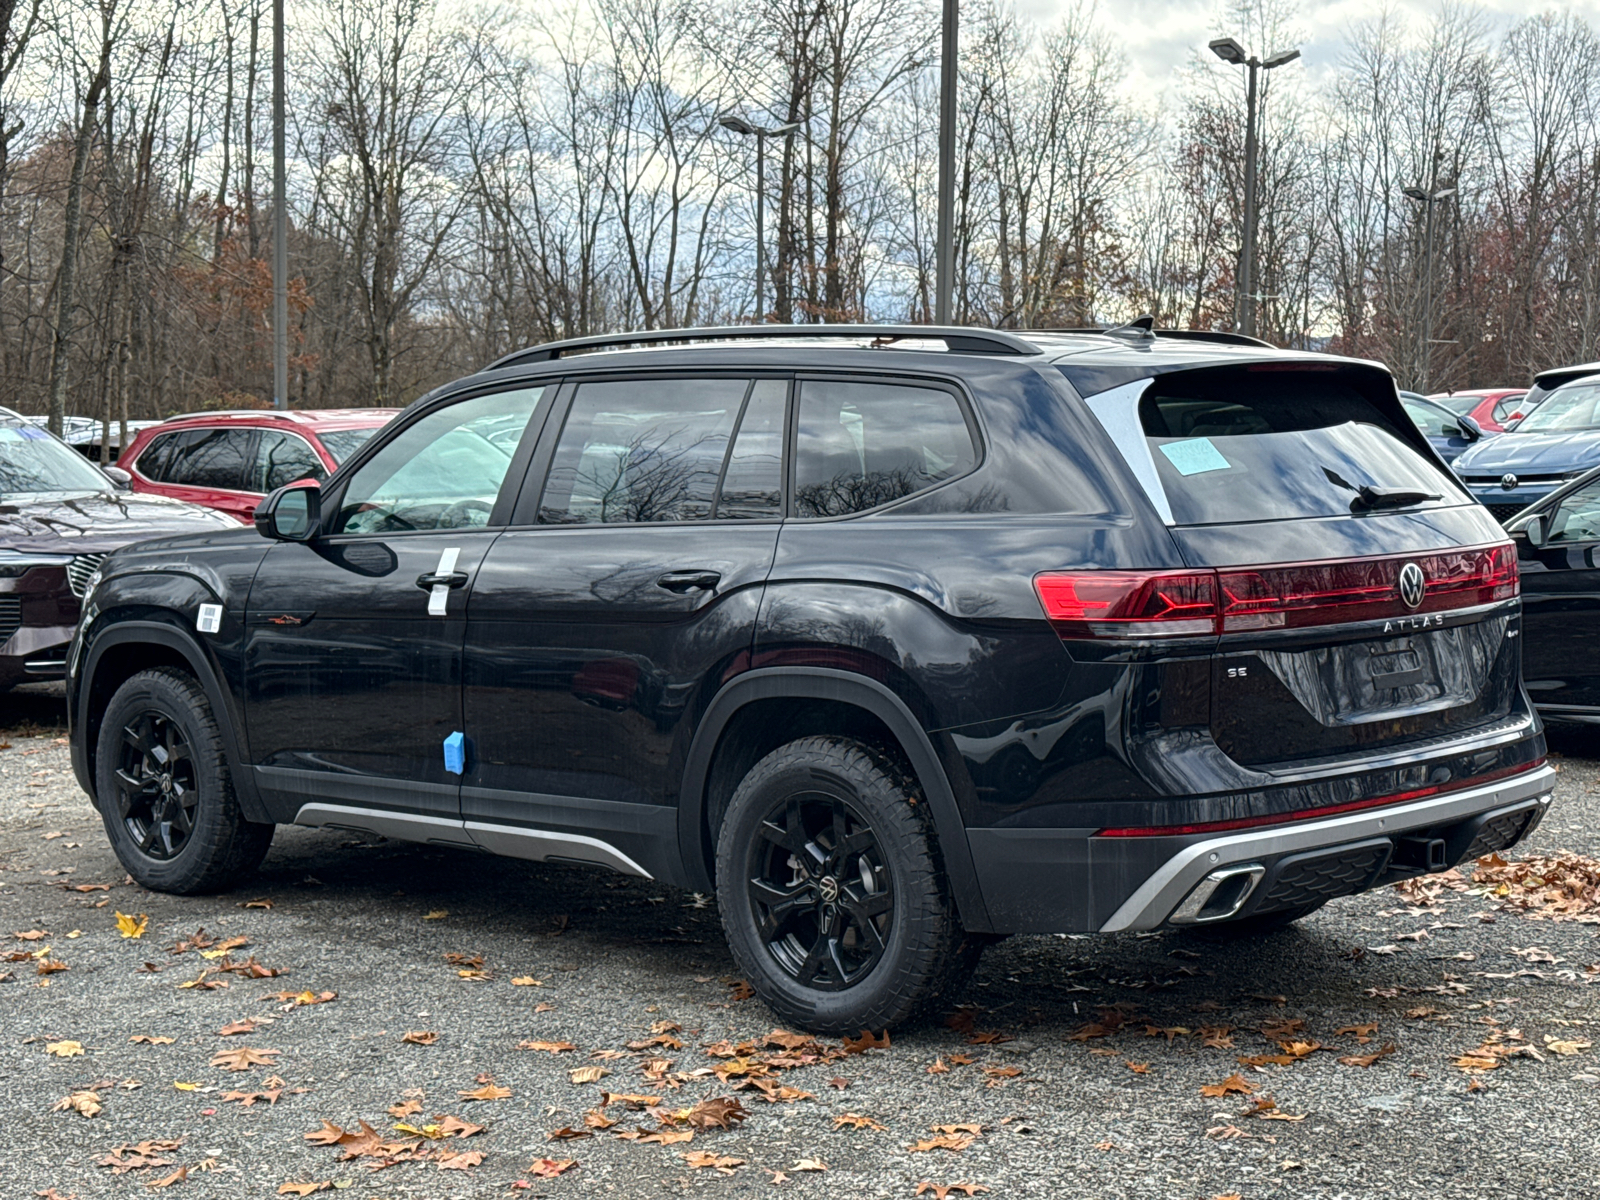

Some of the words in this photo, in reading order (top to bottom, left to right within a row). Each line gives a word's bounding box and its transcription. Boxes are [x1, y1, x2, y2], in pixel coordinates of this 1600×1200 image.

[1400, 562, 1425, 608] VW
[1383, 614, 1443, 633] ATLAS
[1227, 667, 1248, 678] SE
